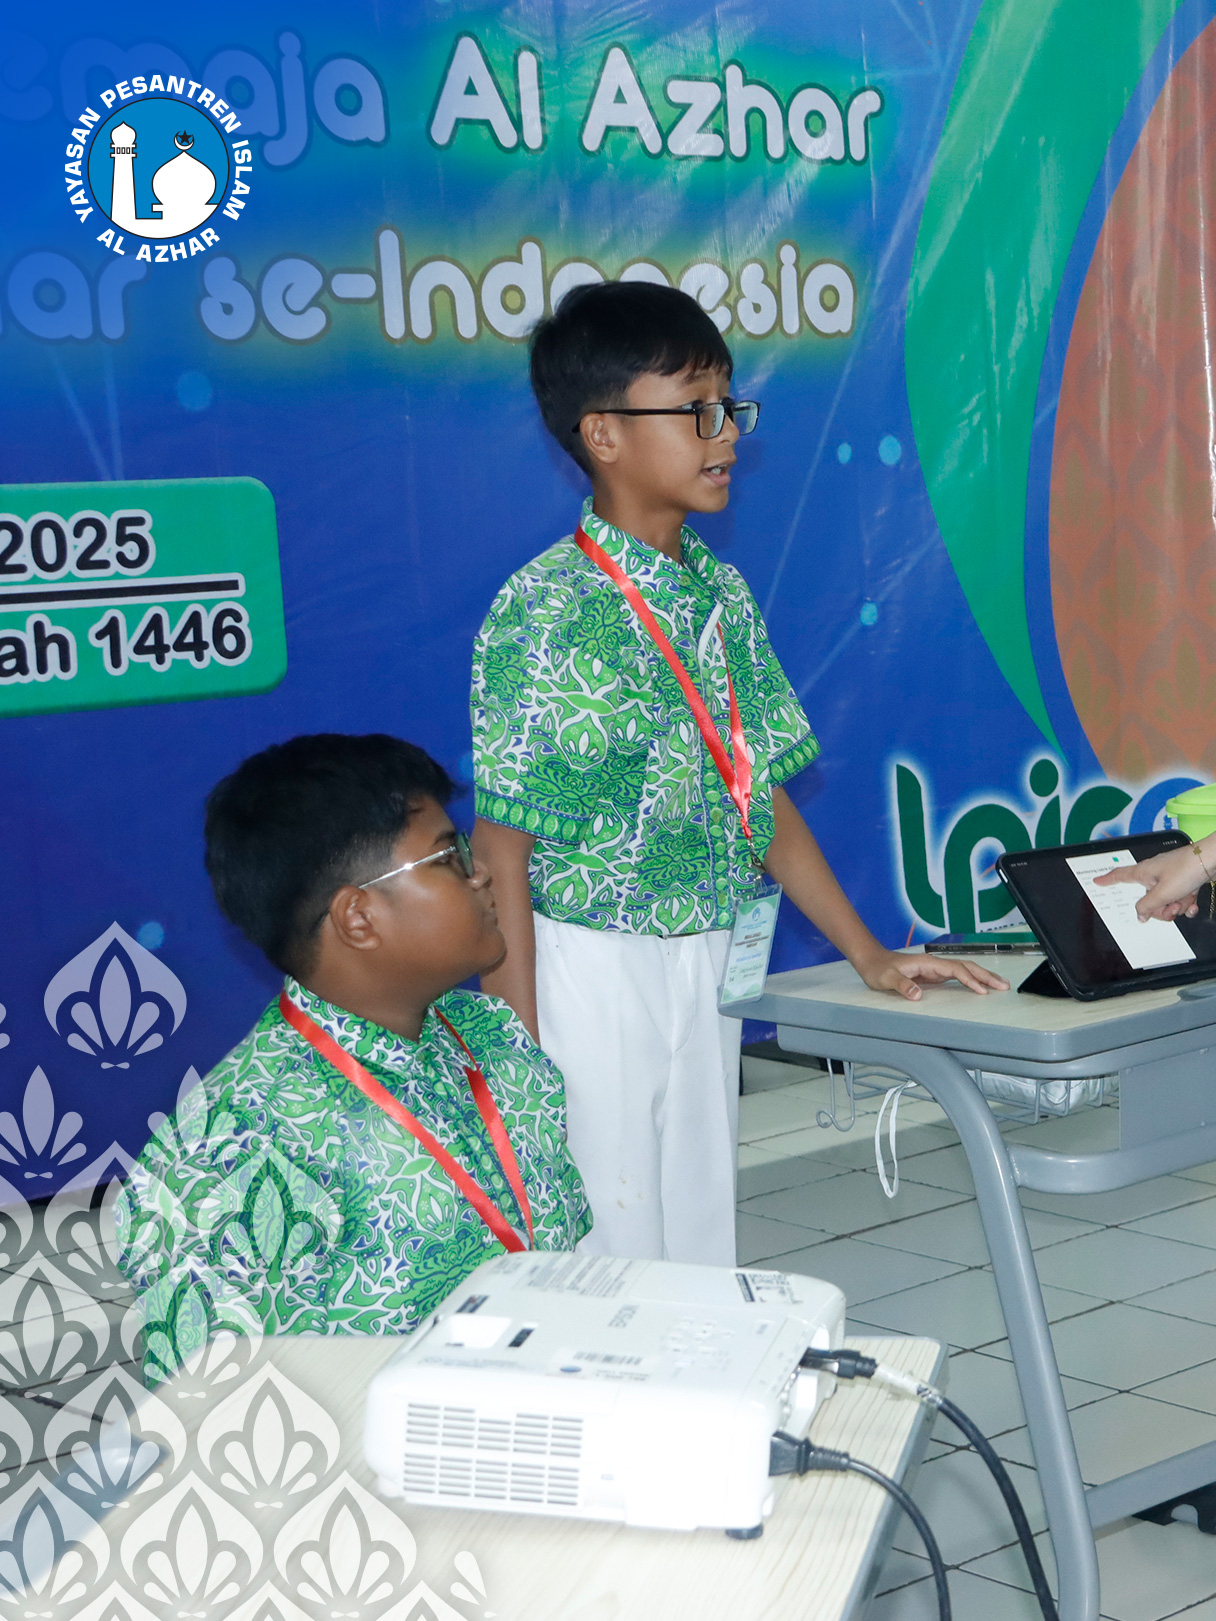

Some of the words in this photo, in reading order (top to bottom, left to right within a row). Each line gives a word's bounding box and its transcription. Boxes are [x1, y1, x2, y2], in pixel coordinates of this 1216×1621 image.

[430, 35, 544, 151] Al
[582, 46, 882, 162] Azhar
[200, 229, 855, 340] se-Indesia
[0, 515, 150, 575] 2025
[94, 606, 248, 670] 1446
